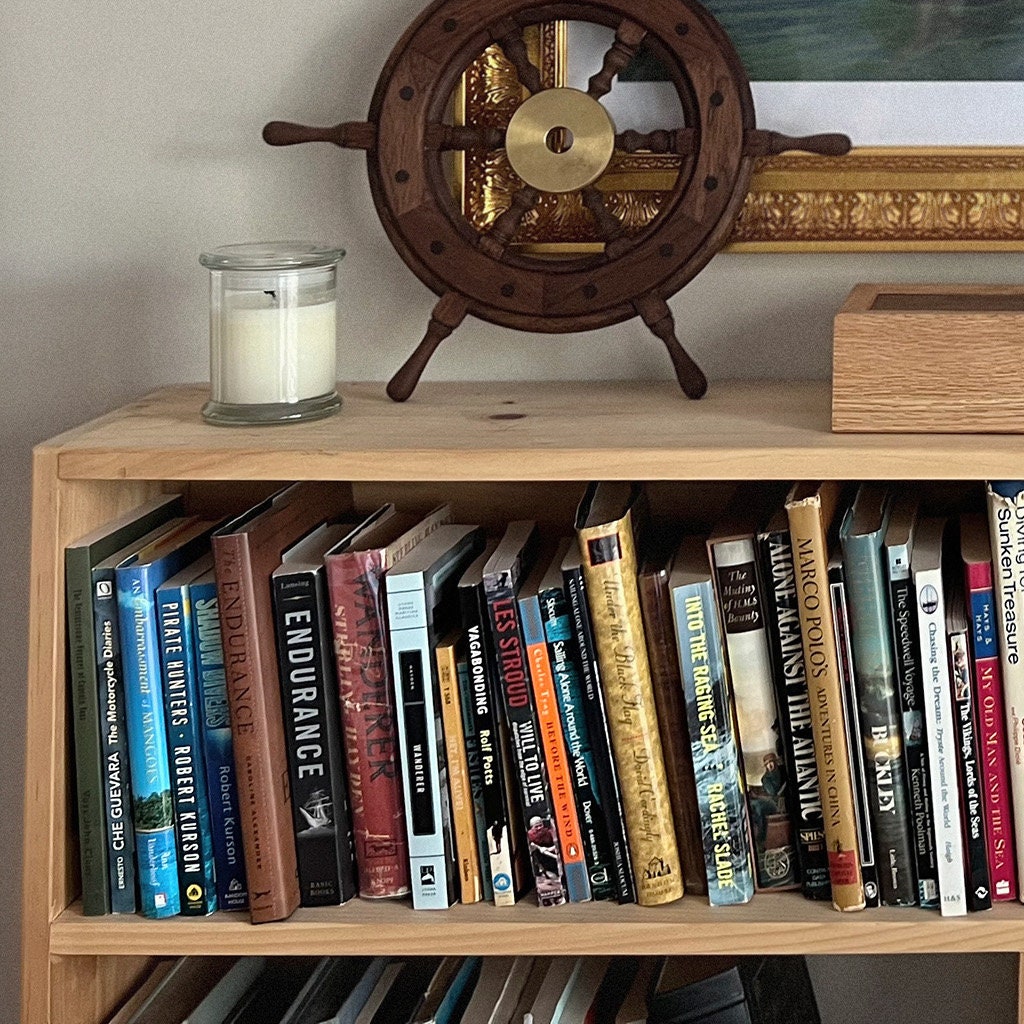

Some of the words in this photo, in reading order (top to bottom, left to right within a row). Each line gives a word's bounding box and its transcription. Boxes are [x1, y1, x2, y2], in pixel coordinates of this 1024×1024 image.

[998, 508, 1013, 579] Sunken
[224, 551, 237, 574] The
[728, 571, 746, 581] The
[769, 541, 796, 603] ALONE
[797, 538, 820, 612] MARCO
[603, 580, 619, 619] Under
[723, 584, 755, 596] Mutiny
[896, 586, 908, 608] The
[162, 602, 183, 654] PIRATE
[493, 598, 516, 632] LES
[546, 598, 558, 626] Slocum
[684, 595, 703, 631] INTO
[727, 610, 759, 624] Bounty
[1003, 580, 1019, 665] Treasure
[103, 620, 112, 658] Diaries
[195, 598, 224, 665] SHADOW
[577, 632, 588, 659] AROUND
[610, 625, 626, 642] the
[689, 632, 707, 663] THE
[777, 606, 807, 686] AGAINST
[806, 616, 828, 678] POLO'S
[897, 610, 914, 666] Speedwell
[928, 622, 938, 664] Chasing
[985, 637, 992, 645] &
[222, 581, 254, 736] ENDURANCE
[467, 625, 488, 715] VAGABONDING
[500, 636, 528, 707] STROUD
[552, 641, 566, 672] Sailing
[614, 645, 636, 689] Black
[931, 666, 940, 682] the
[103, 659, 117, 723] Motorcycle
[131, 579, 141, 594] AN
[142, 711, 159, 784] MANGOES
[167, 660, 188, 726] HUNTERS
[352, 569, 396, 782] WANDERER
[557, 672, 572, 703] Alone
[903, 666, 916, 707] Voyage
[981, 666, 993, 691] MY
[202, 668, 230, 728] DIVERS
[284, 609, 324, 779] ENDURANCE
[618, 692, 640, 725] Flag
[693, 666, 716, 723] RAGING
[933, 685, 944, 725] Dream:
[959, 702, 969, 721] The
[982, 695, 994, 727] OLD
[563, 704, 580, 741] Around
[787, 694, 811, 732] THE
[816, 687, 834, 765] ADVENTURES
[108, 724, 118, 745] The
[480, 729, 493, 753] Rolf
[519, 720, 536, 753] WILL
[533, 648, 545, 687] Charles
[546, 721, 560, 769] BEFORE
[555, 775, 567, 800] THE
[561, 803, 573, 837] WIND
[571, 741, 582, 757] the
[700, 724, 719, 754] SEA
[936, 727, 944, 754] Tryste
[961, 723, 973, 759] Vikings,
[986, 731, 998, 767] MAN
[174, 745, 195, 804] ROBERT
[413, 744, 425, 793] WANDERER
[482, 756, 494, 786] Potts
[524, 753, 538, 772] TO
[574, 757, 589, 787] World
[632, 748, 652, 786] David
[792, 736, 823, 821] ATLANTIC
[826, 768, 836, 783] IN
[938, 755, 948, 787] Around
[965, 760, 976, 786] Lords
[108, 752, 123, 818] GUEVARA
[219, 766, 232, 813] Robert
[527, 774, 545, 804] LIVE
[911, 768, 922, 810] Kenneth
[940, 788, 948, 802] the
[967, 787, 978, 799] of
[989, 772, 1000, 803] AND
[246, 756, 256, 807] CAROLINE
[251, 810, 262, 870] ALEXANDER
[583, 800, 593, 825] Dover
[638, 788, 661, 843] Cordingly
[707, 782, 727, 841] RACHEL
[827, 786, 841, 827] CHINA
[941, 803, 951, 829] World
[969, 800, 979, 815] the
[991, 808, 1003, 834] THE
[112, 821, 124, 851] CHE
[180, 812, 201, 874] KURSON
[224, 817, 237, 865] Kurson
[915, 812, 927, 856] Poolman
[971, 816, 980, 839] Seas
[714, 843, 734, 889] SLADE
[994, 838, 1005, 869] SEA
[943, 895, 960, 903] H&S
